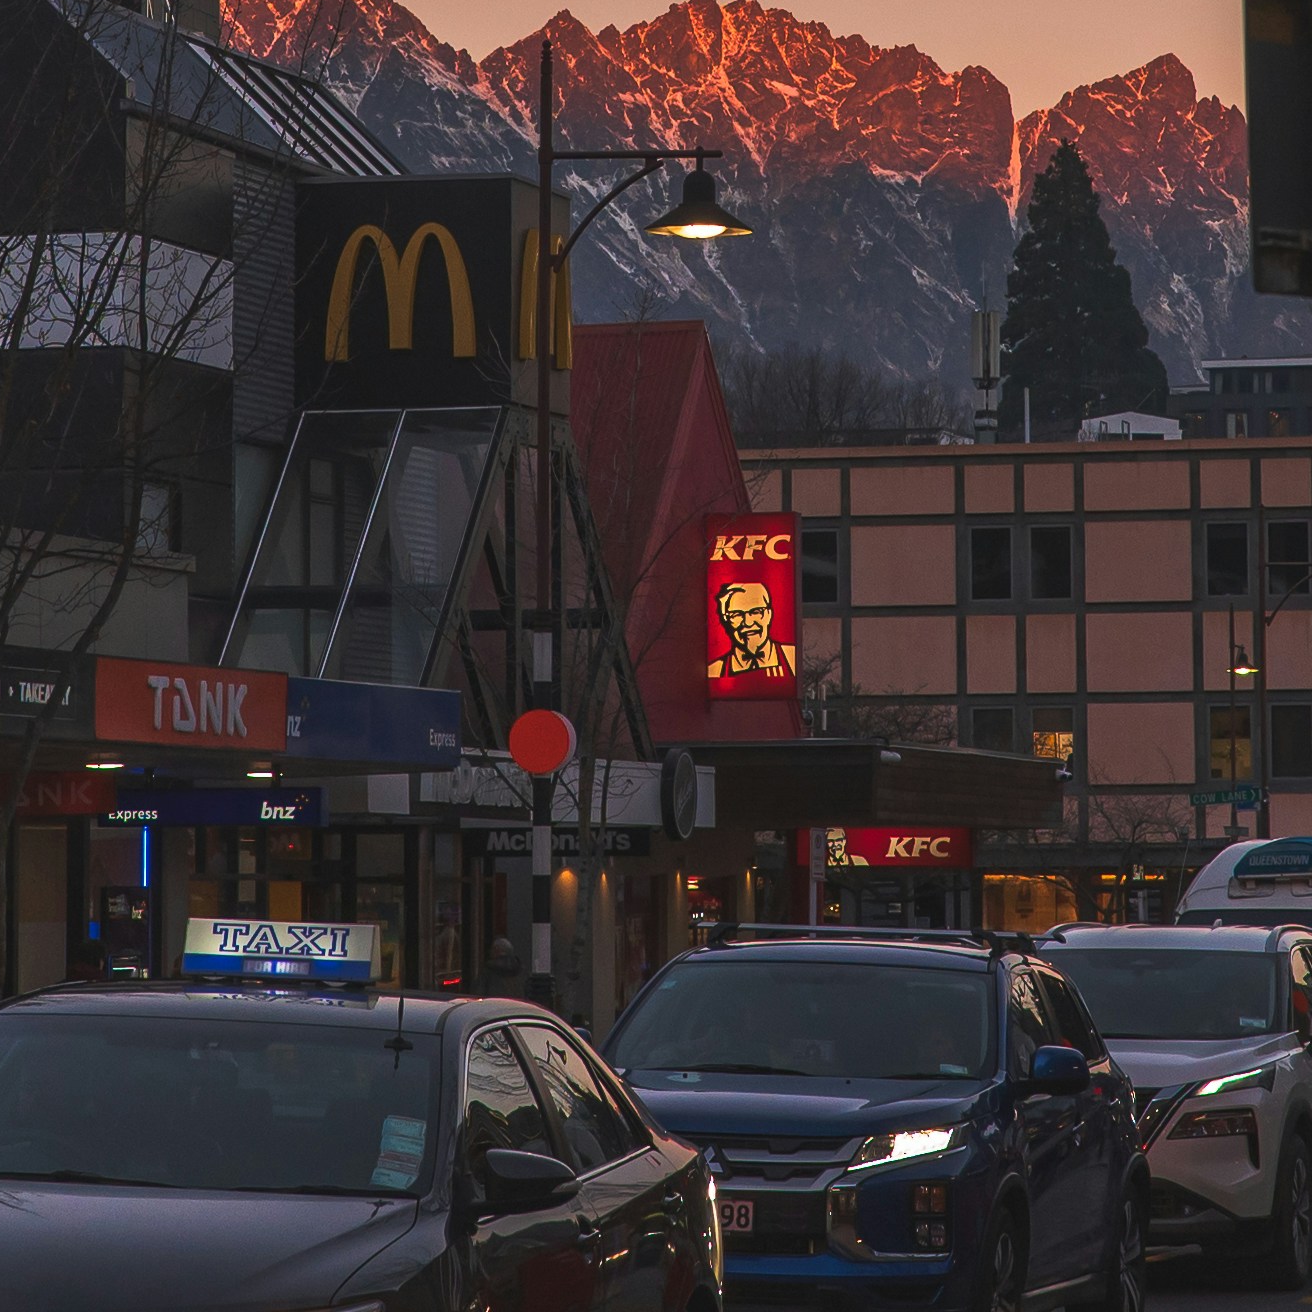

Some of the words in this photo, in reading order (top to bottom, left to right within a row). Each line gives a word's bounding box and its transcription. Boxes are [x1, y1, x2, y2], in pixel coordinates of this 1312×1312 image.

[710, 534, 792, 561] KFC
[148, 674, 248, 737] TANK
[429, 728, 456, 751] Express
[1193, 794, 1216, 805] COW
[1222, 790, 1247, 802] LANE
[260, 801, 296, 821] bnz
[885, 837, 951, 858] KFC
[1249, 855, 1310, 866] QUEENSTOWN
[213, 922, 350, 958] TAXI
